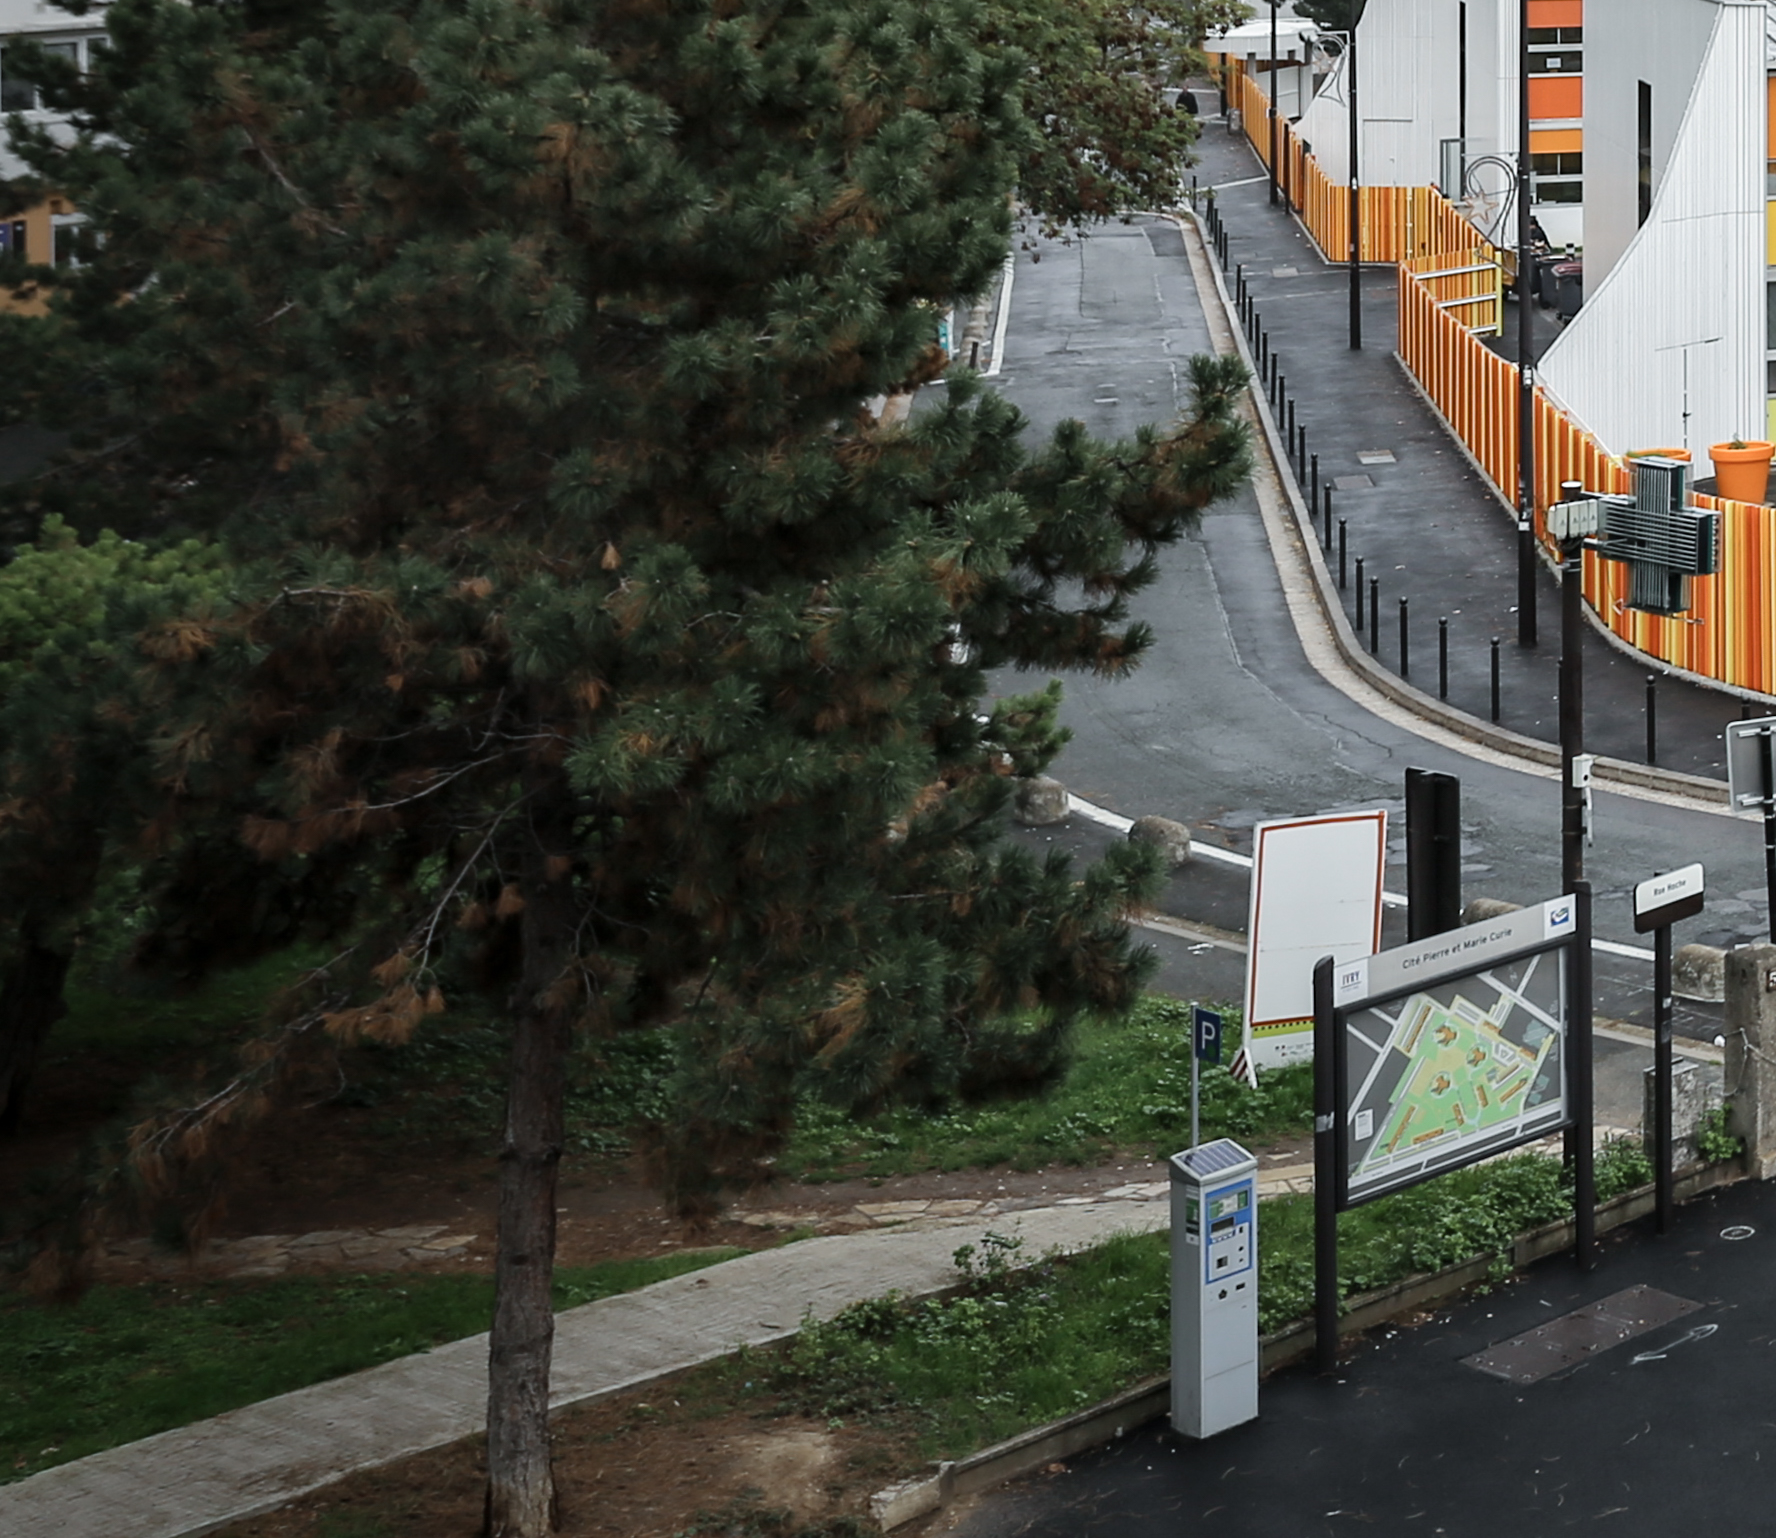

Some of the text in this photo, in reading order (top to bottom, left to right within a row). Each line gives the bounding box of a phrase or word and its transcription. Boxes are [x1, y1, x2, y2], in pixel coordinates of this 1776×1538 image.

[1654, 887, 1665, 896] Rue
[1402, 929, 1512, 969] Cité Pierre et Marie Curie
[1342, 971, 1360, 985] IVRY
[1202, 1021, 1216, 1050] P
